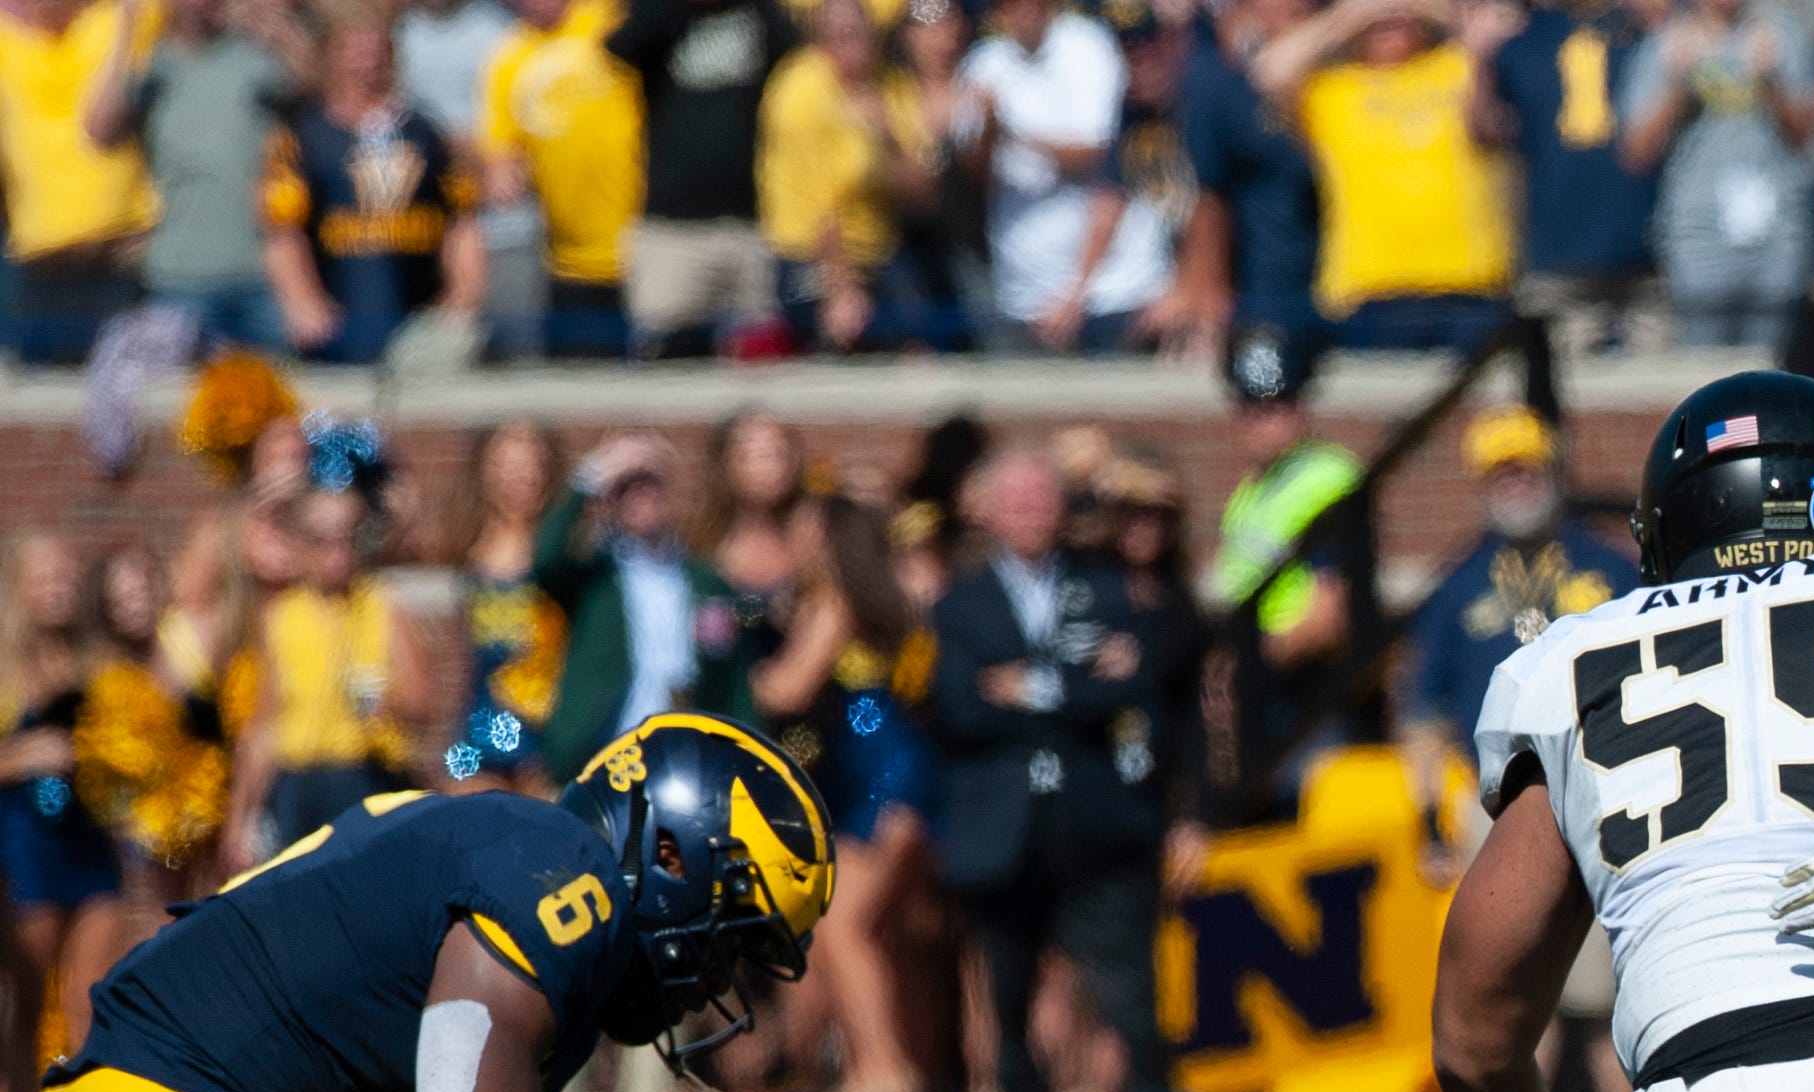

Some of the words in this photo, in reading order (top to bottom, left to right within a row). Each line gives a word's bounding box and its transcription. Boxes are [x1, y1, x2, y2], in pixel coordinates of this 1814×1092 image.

[1714, 540, 1779, 569] WEST
[536, 873, 613, 947] 6
[1180, 862, 1377, 1052] N
